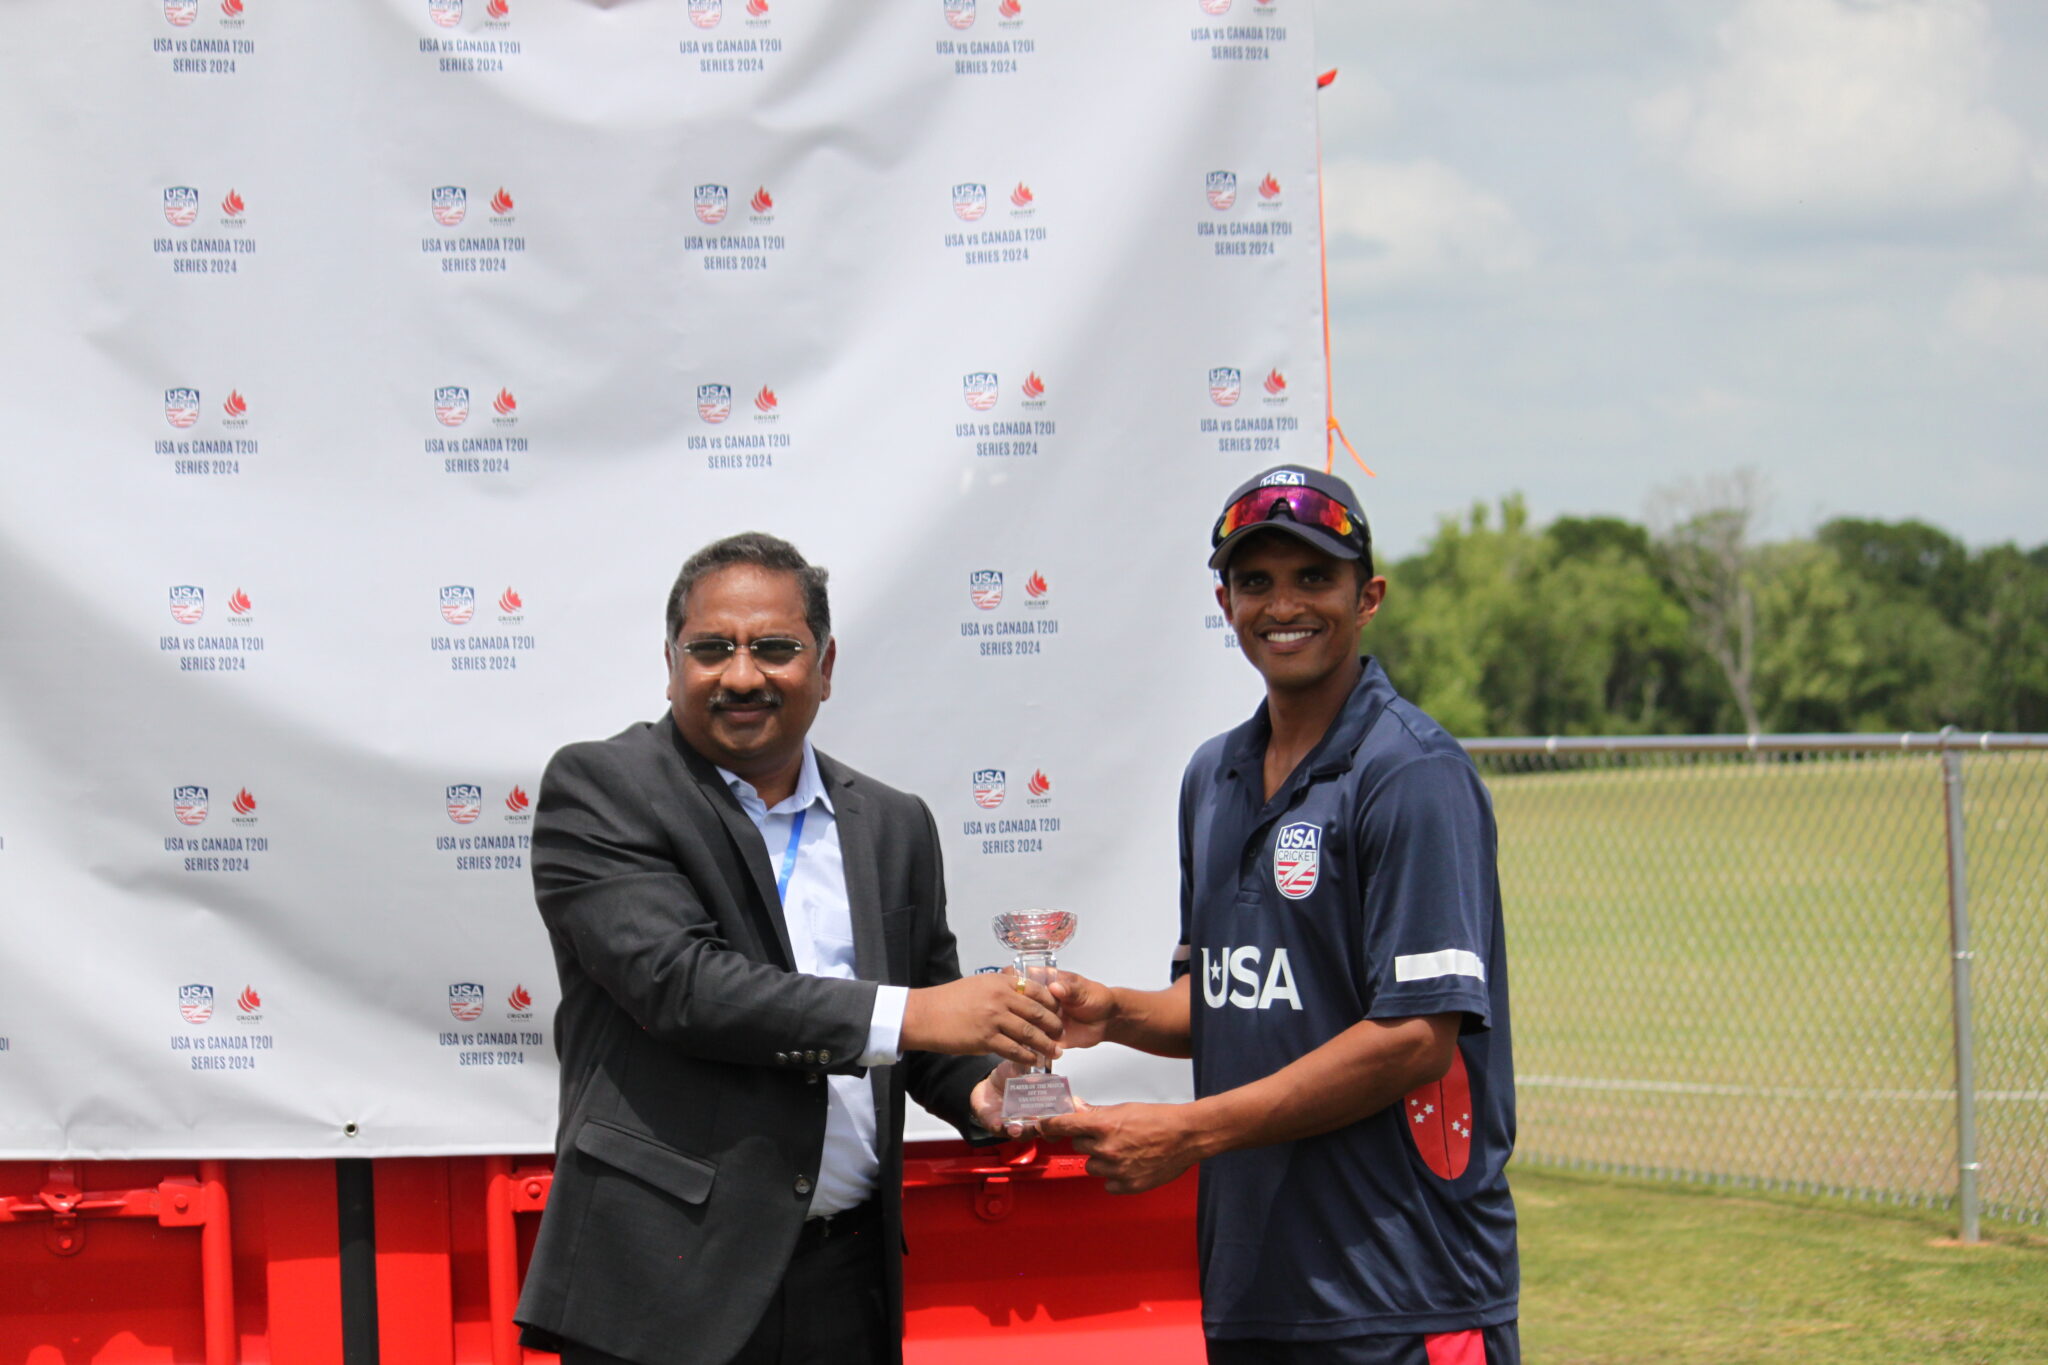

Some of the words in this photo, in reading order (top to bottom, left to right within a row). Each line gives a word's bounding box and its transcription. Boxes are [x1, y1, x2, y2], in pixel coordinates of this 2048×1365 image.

[154, 38, 173, 52] USA
[190, 39, 230, 52] CANADA
[420, 38, 439, 52] USA
[456, 40, 496, 53] CANADA
[680, 40, 699, 54] USA
[716, 40, 757, 53] CANADA
[936, 40, 954, 54] USA
[970, 40, 1010, 55] CANADA
[173, 58, 206, 72] SERIES
[210, 59, 235, 73] 2024
[440, 58, 473, 72] SERIES
[477, 58, 503, 71] 2024
[700, 59, 734, 72] SERIES
[738, 58, 764, 72] 2024
[955, 60, 988, 75] SERIES
[991, 60, 1017, 74] 2024
[1198, 222, 1215, 236] USA
[1230, 222, 1269, 236] CANADA
[154, 238, 173, 252] USA
[190, 238, 231, 252] CANADA
[422, 238, 442, 252] USA
[459, 238, 500, 252] CANADA
[684, 236, 704, 250] USA
[720, 236, 760, 250] CANADA
[945, 234, 964, 247] USA
[981, 230, 1022, 244] CANADA
[1215, 242, 1247, 256] SERIES
[1248, 241, 1274, 255] 2024
[704, 256, 738, 270] SERIES
[740, 256, 766, 270] 2024
[965, 250, 1000, 264] SERIES
[1002, 248, 1029, 262] 2024
[174, 258, 208, 272] SERIES
[211, 259, 236, 273] 2024
[442, 258, 476, 272] SERIES
[480, 258, 506, 272] 2024
[956, 424, 976, 437] USA
[993, 422, 1032, 436] CANADA
[1200, 419, 1219, 432] USA
[1234, 417, 1274, 432] CANADA
[155, 440, 175, 454] USA
[192, 440, 233, 454] CANADA
[425, 439, 444, 452] USA
[462, 438, 503, 452] CANADA
[688, 436, 707, 450] USA
[724, 435, 765, 448] CANADA
[977, 442, 1010, 456] SERIES
[1013, 442, 1038, 456] 2024
[1219, 438, 1252, 452] SERIES
[1254, 438, 1280, 451] 2024
[175, 460, 209, 474] SERIES
[212, 460, 239, 474] 2024
[445, 459, 480, 472] SERIES
[482, 458, 509, 472] 2024
[708, 455, 742, 468] SERIES
[746, 454, 772, 468] 2024
[961, 622, 980, 636] USA
[996, 621, 1034, 635] CANADA
[1205, 616, 1224, 629] USA
[160, 636, 180, 650] USA
[198, 636, 239, 650] CANADA
[431, 637, 451, 650] USA
[468, 636, 510, 650] CANADA
[980, 641, 1012, 656] SERIES
[1016, 641, 1040, 655] 2024
[180, 657, 215, 671] SERIES
[218, 657, 245, 670] 2024
[452, 656, 486, 670] SERIES
[489, 656, 516, 670] 2024
[975, 772, 1004, 782] USA
[964, 821, 982, 835] USA
[999, 819, 1036, 834] CANADA
[164, 837, 184, 851] USA
[202, 838, 243, 851] CANADA
[436, 836, 456, 850] USA
[474, 835, 515, 850] CANADA
[1281, 828, 1316, 849] USA
[982, 840, 1015, 854] SERIES
[1018, 839, 1042, 852] 2024
[457, 856, 491, 870] SERIES
[494, 856, 522, 869] 2024
[1278, 850, 1316, 862] CRICKET
[185, 858, 219, 871] SERIES
[222, 858, 248, 871] 2024
[1201, 945, 1303, 1010] USA
[171, 1036, 191, 1050] USA
[208, 1036, 248, 1050] CANADA
[440, 1032, 459, 1046] USA
[477, 1032, 518, 1045] CANADA
[192, 1056, 226, 1070] SERIES
[228, 1056, 254, 1069] 2024
[460, 1052, 494, 1066] SERIES
[497, 1052, 524, 1064] 2024
